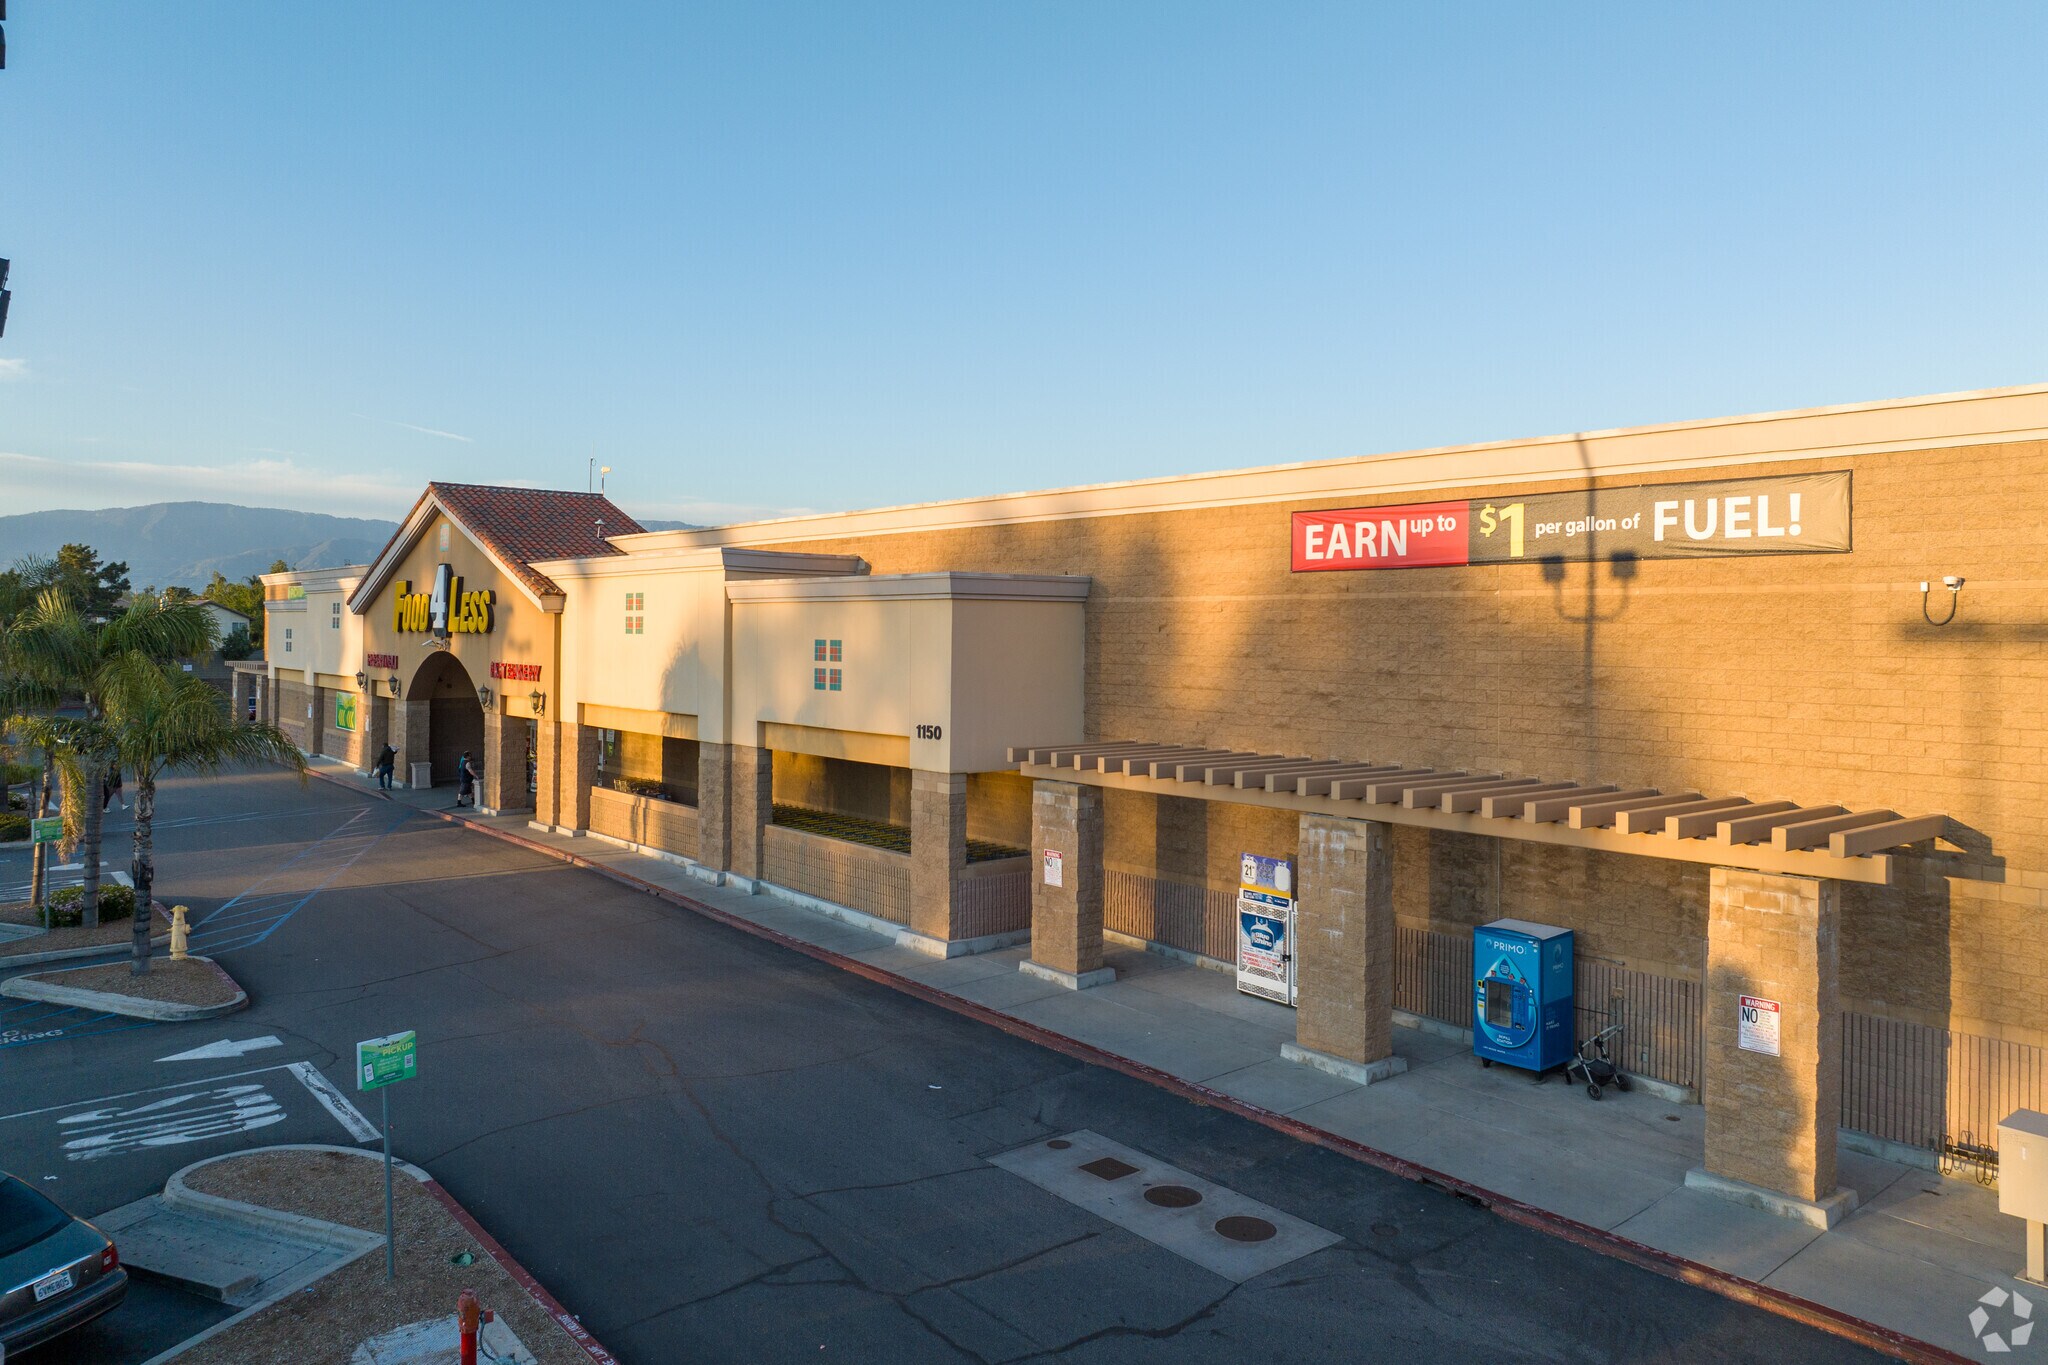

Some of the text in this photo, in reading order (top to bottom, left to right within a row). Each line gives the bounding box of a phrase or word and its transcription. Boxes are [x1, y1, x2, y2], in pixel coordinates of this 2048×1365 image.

[1305, 492, 1802, 560] EARN up to $1 per gallon of FUEL!
[430, 564, 453, 637] 4
[916, 724, 942, 741] 1150
[1494, 941, 1525, 955] PRIMO
[1745, 999, 1775, 1010] WARNING
[1742, 1006, 1758, 1024] NO
[383, 1041, 414, 1057] PICKUP
